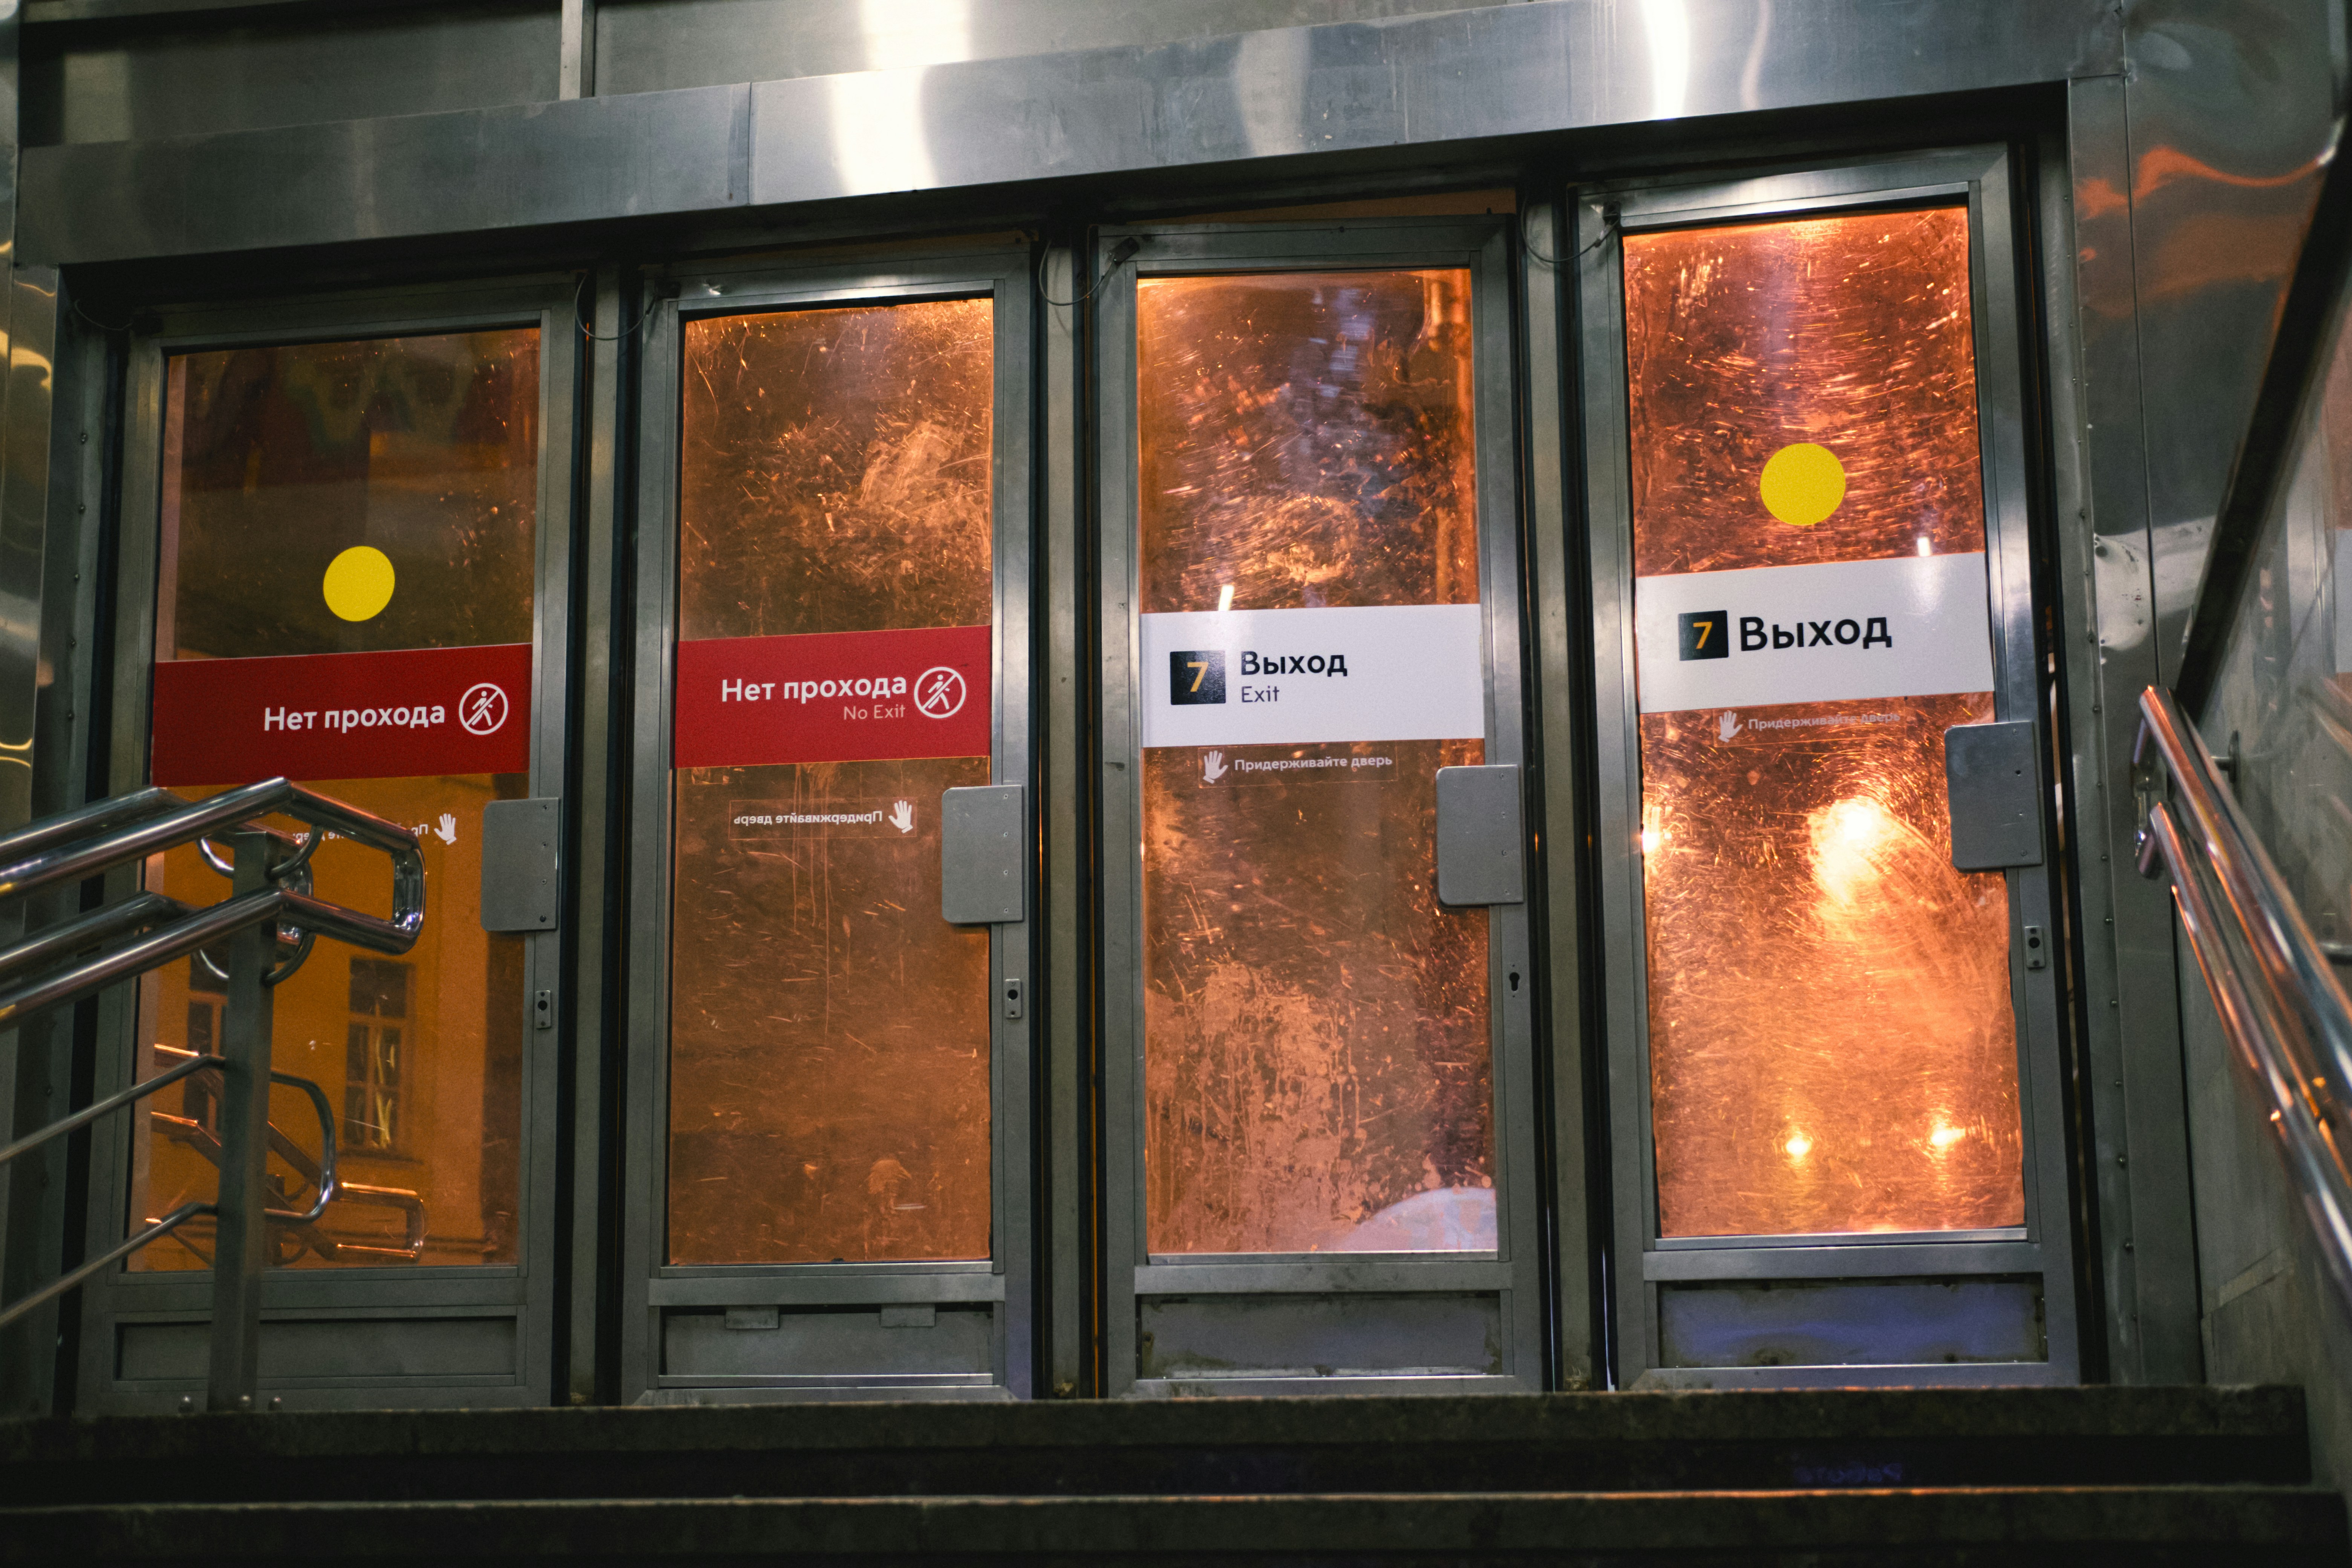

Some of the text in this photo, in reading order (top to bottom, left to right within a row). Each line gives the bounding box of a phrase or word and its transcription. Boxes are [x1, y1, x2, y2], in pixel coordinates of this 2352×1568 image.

[1693, 616, 1892, 652] 7 Выход
[1187, 651, 1348, 692] 7 Выход
[722, 676, 907, 704] Нет прохода
[1241, 686, 1280, 703] Exit
[264, 705, 445, 733] Нет прохода
[844, 704, 906, 720] No Exit
[1748, 711, 1900, 731] Придерживайте дверь
[1234, 755, 1392, 772] Придерживайте дверь
